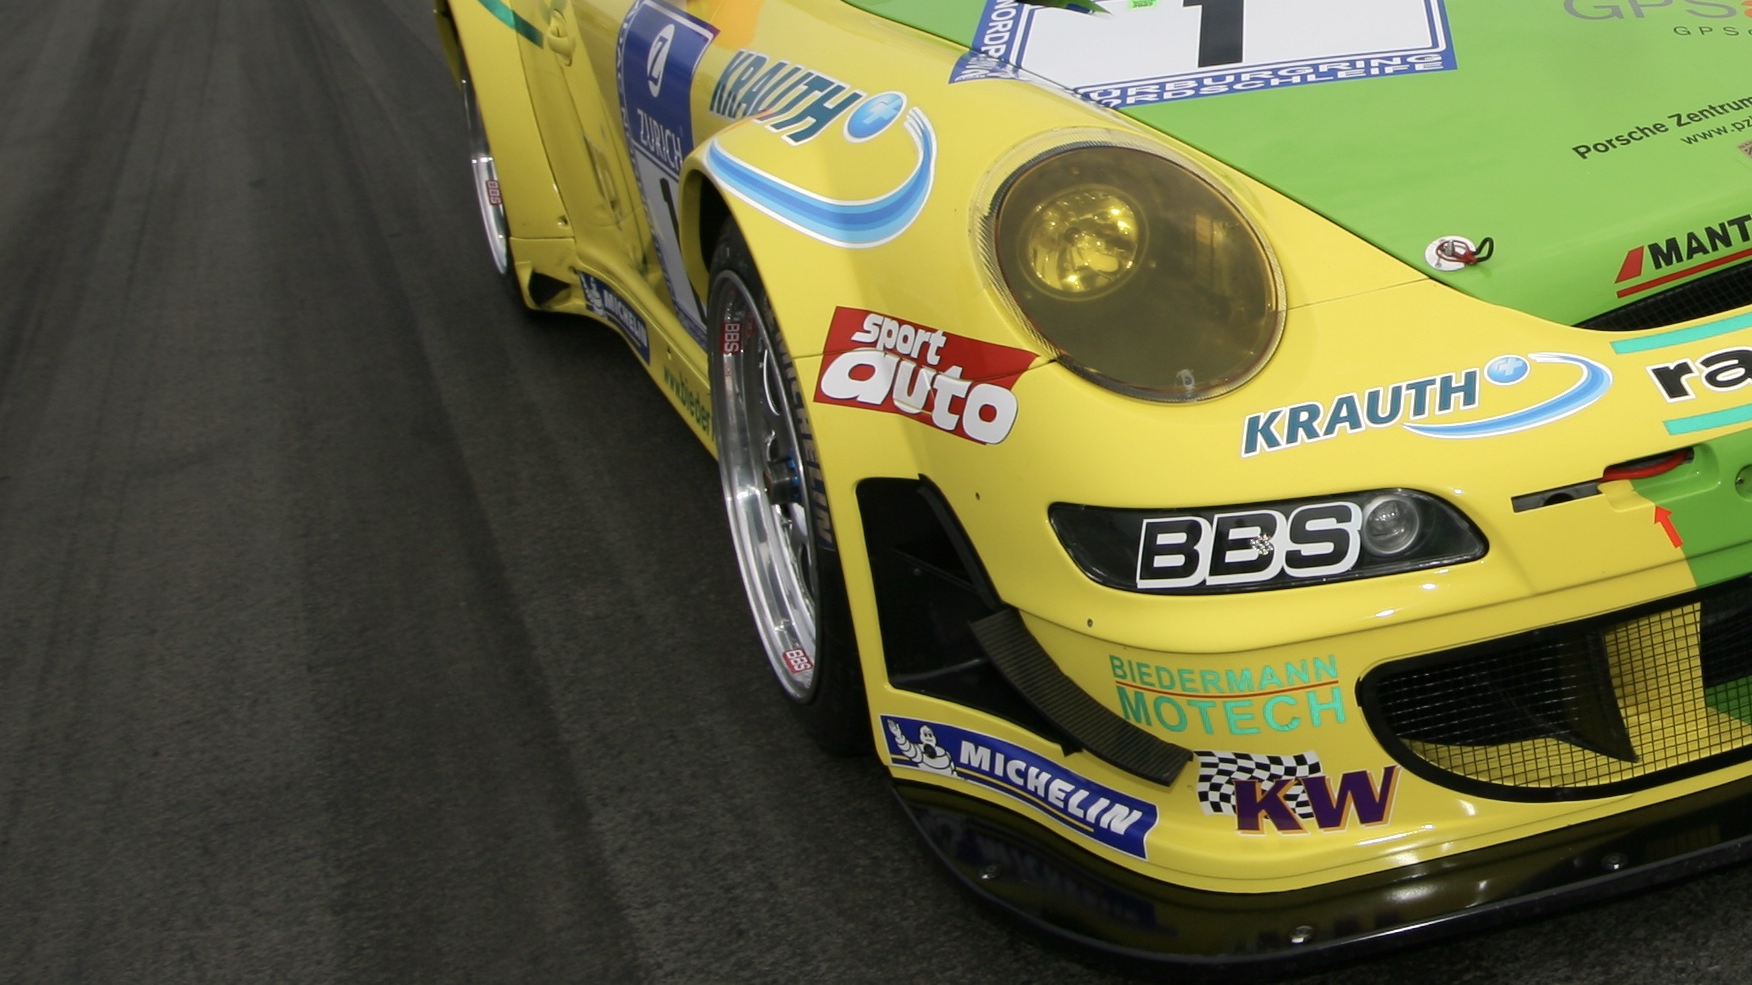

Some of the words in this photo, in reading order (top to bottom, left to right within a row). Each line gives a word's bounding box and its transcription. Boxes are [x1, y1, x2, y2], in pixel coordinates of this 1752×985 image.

[709, 50, 865, 143] KRAUTH
[1101, 62, 1444, 107] ORDSCHLEIFE
[637, 108, 683, 171] ZURICH
[1571, 122, 1669, 160] Porsche
[603, 289, 648, 348] MICHELIN
[724, 323, 741, 353] BBS
[851, 313, 947, 365] sport
[820, 347, 1018, 445] auto
[1244, 370, 1478, 454] KRAUTH
[1137, 501, 1363, 588] BBS
[785, 649, 812, 671] BBS
[1110, 653, 1339, 693] BIEDERMANN
[1116, 684, 1347, 735] MOTECH
[959, 740, 1144, 838] MICHELIN
[1235, 764, 1402, 836] KW
